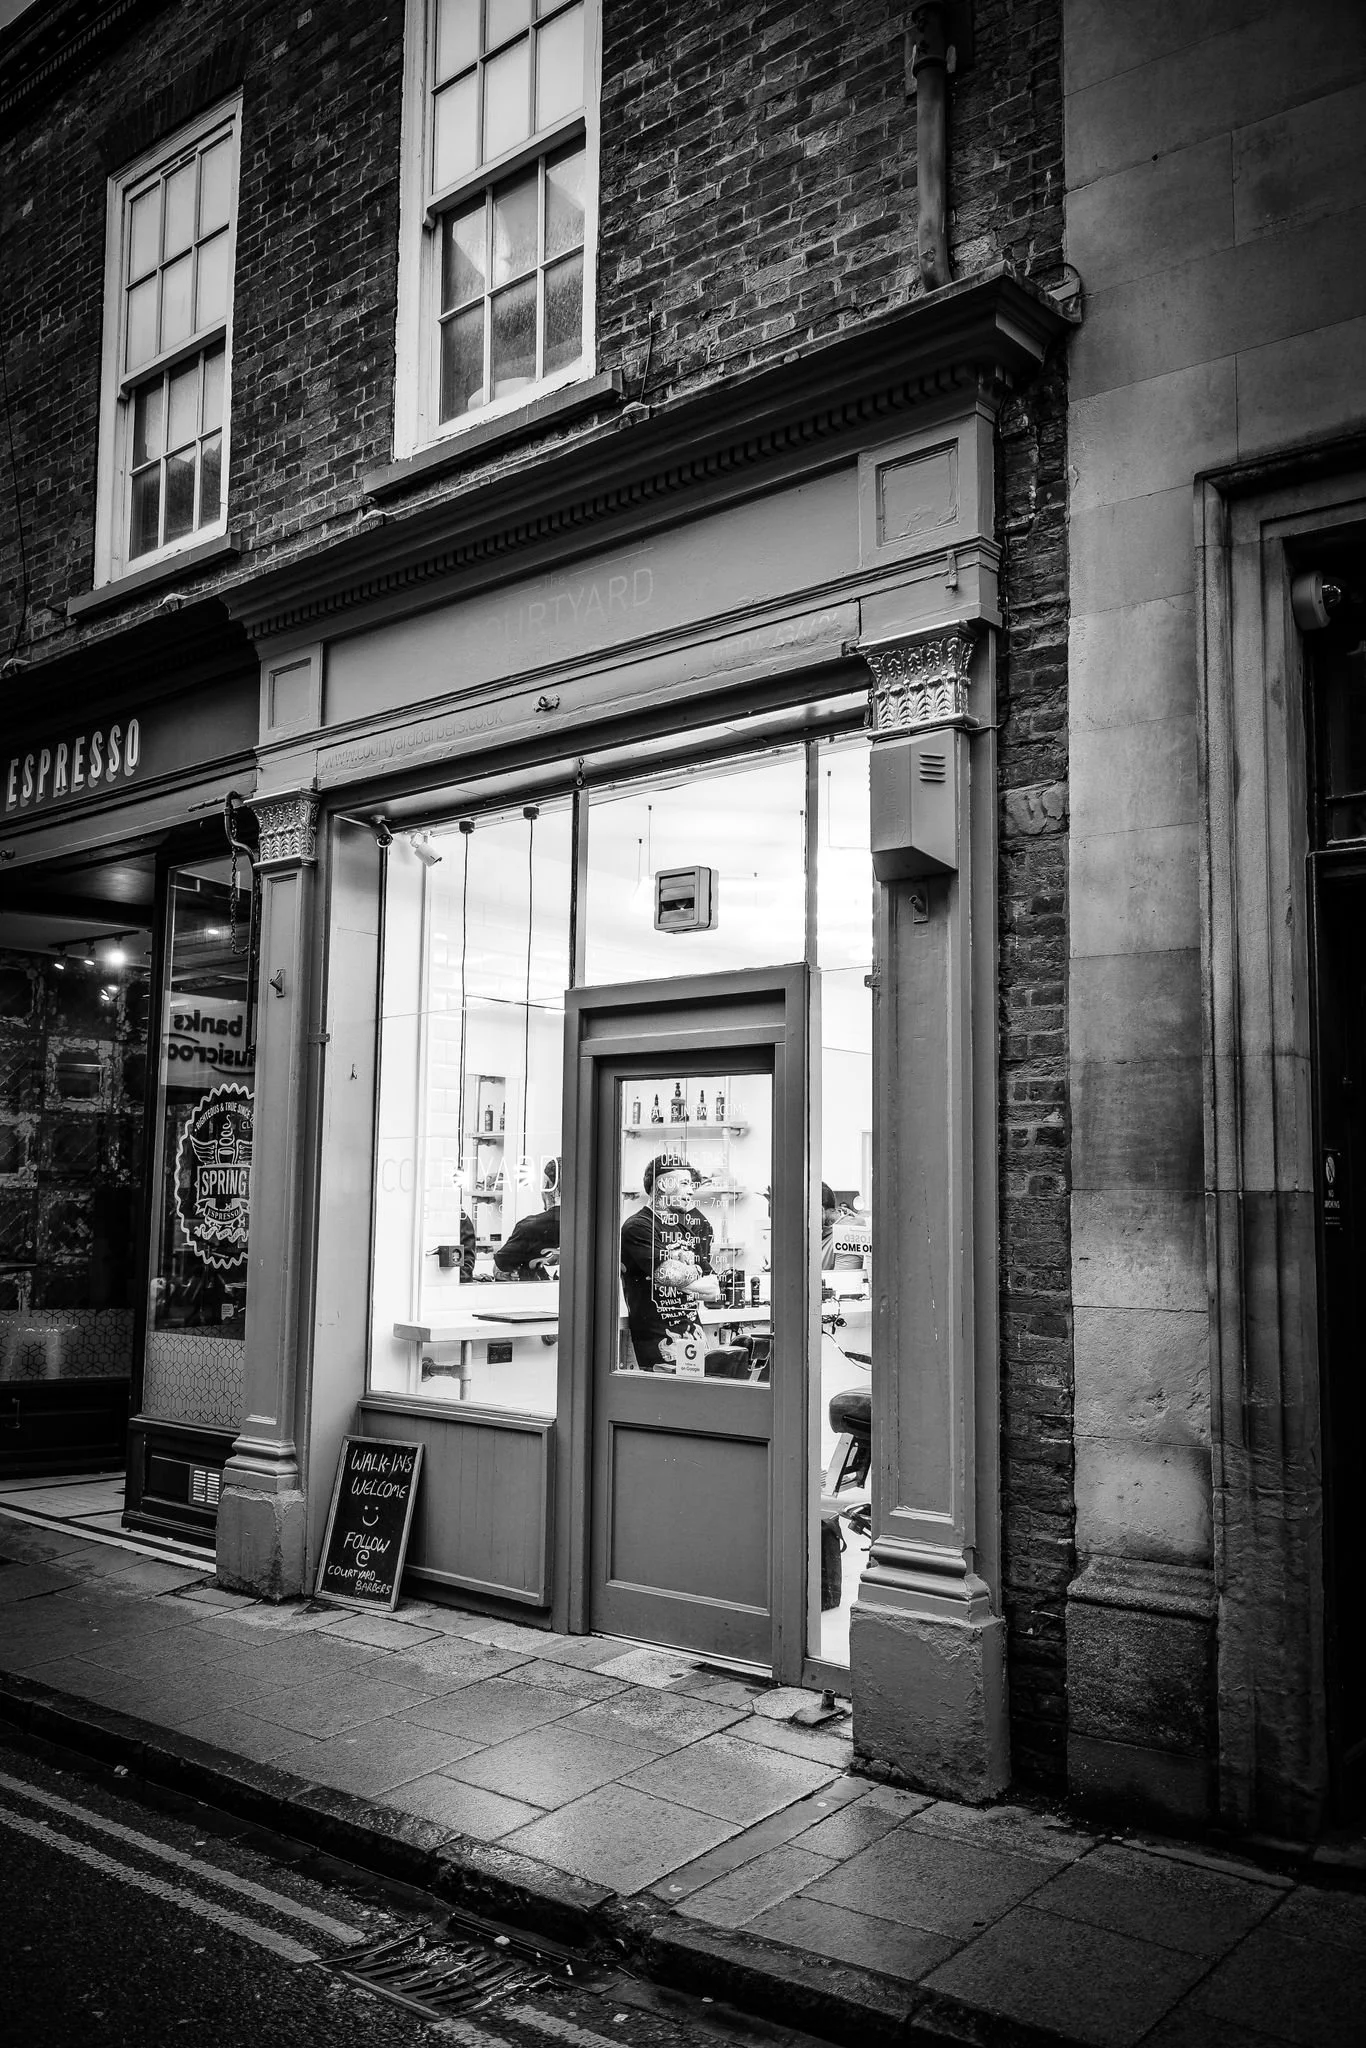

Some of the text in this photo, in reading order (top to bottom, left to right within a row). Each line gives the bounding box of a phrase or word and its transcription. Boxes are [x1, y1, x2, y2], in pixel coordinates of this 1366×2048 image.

[6, 718, 140, 812] ESPRESSO
[195, 1104, 220, 1130] RIGHTEOUS
[225, 1101, 238, 1112] TRUE
[201, 1169, 247, 1196] SPRING
[661, 1195, 682, 1207] TUES
[207, 1208, 239, 1220] ESPRESSO
[661, 1213, 679, 1225] WED
[685, 1213, 700, 1225] 9am
[660, 1231, 682, 1243] THUR
[685, 1231, 700, 1244] 9am
[835, 1243, 861, 1253] COME
[658, 1286, 677, 1298] SUN
[684, 1343, 698, 1361] G
[351, 1450, 413, 1477] WALK-INS
[351, 1477, 409, 1499] WELCOME
[343, 1531, 391, 1554] FOLLOW
[355, 1550, 370, 1568] @
[355, 1579, 393, 1595] BARBERS
